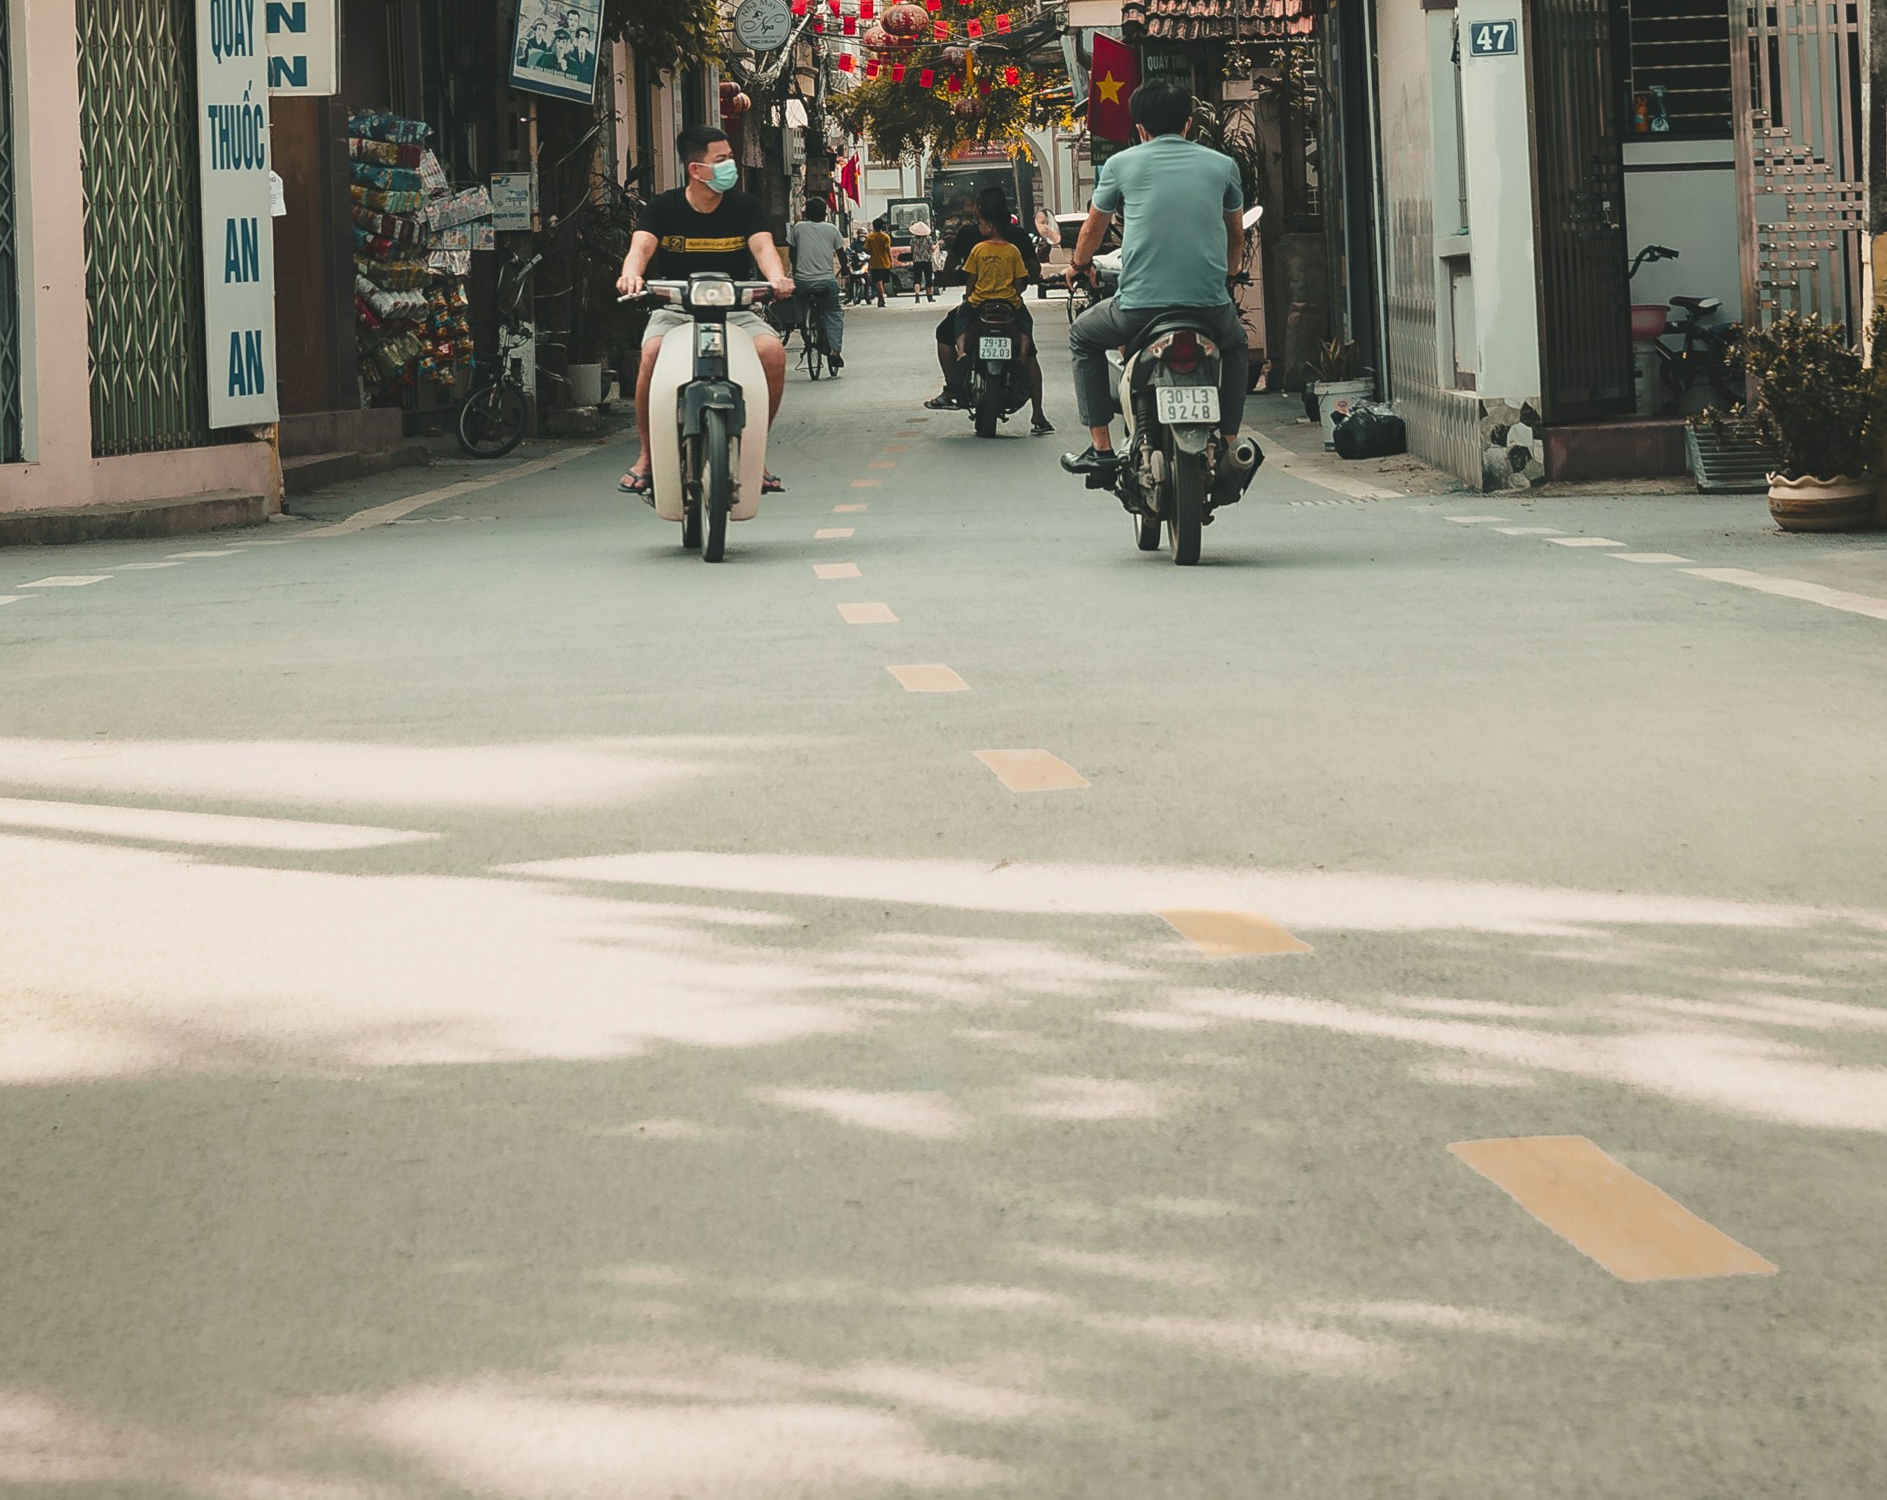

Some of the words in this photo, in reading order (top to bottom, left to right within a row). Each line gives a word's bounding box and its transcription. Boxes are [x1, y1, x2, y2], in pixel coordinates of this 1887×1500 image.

[1476, 24, 1509, 51] 47
[208, 80, 265, 171] THUỐC
[224, 217, 260, 284] AN
[228, 329, 264, 397] AN
[1168, 405, 1210, 420] 9248
